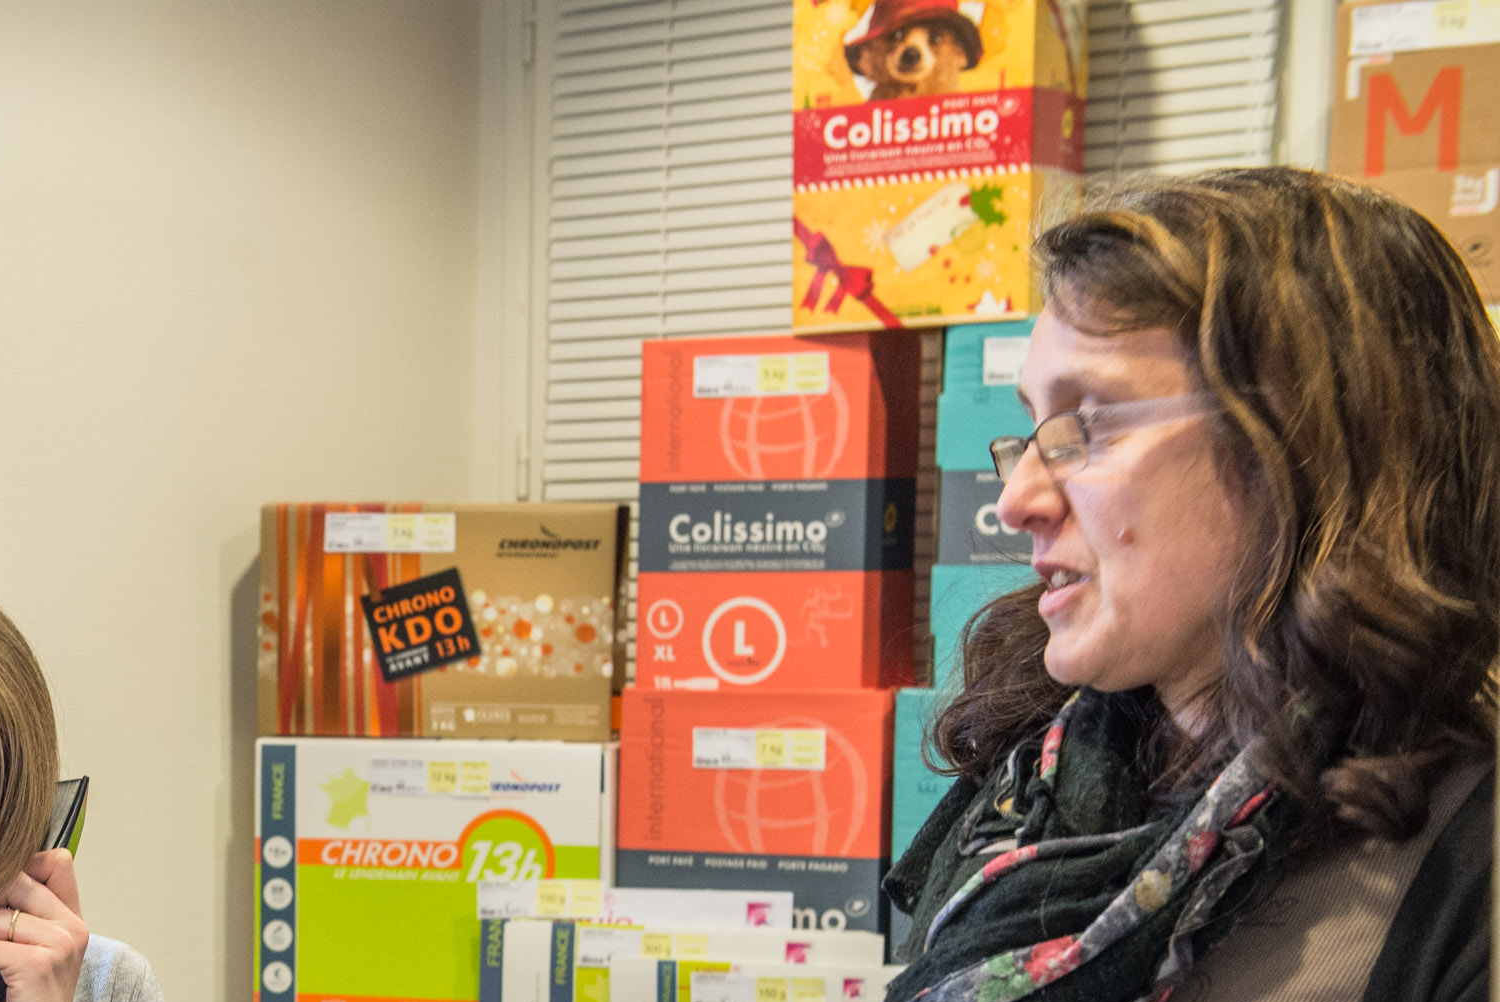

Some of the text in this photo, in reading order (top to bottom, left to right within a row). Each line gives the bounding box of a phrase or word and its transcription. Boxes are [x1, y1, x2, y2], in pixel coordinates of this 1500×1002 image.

[823, 104, 999, 149] Colissimo
[1363, 66, 1464, 178] M
[499, 538, 602, 550] CHRONOPOST
[668, 510, 828, 544] Colissimo
[373, 585, 456, 624] CHRONO
[377, 605, 463, 654] KDO
[734, 620, 755, 657] L
[653, 644, 676, 662] XL
[644, 695, 665, 841] international
[271, 762, 286, 820] FRANCE
[321, 839, 544, 884] CHRONO 13h
[486, 918, 502, 968] FRAN
